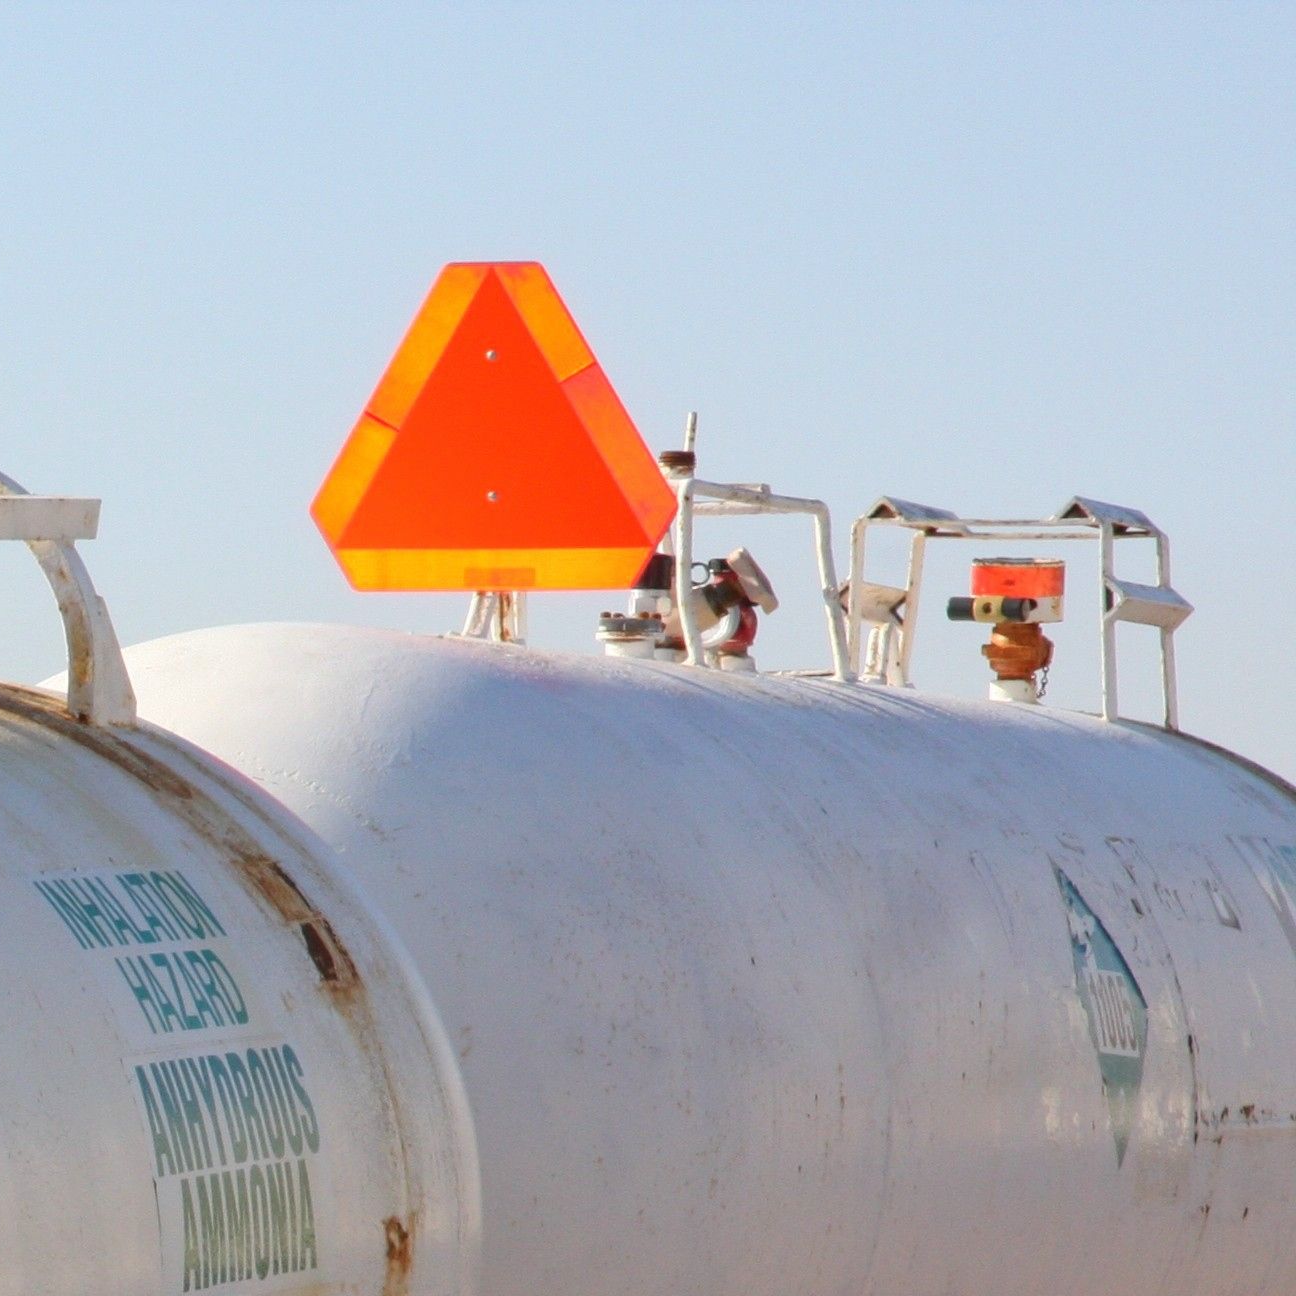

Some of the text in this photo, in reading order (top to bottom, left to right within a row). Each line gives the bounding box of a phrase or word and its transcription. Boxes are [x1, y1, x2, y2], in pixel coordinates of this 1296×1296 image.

[32, 870, 228, 950] INHALATION
[113, 949, 249, 1034] HAZARD
[134, 1042, 321, 1178] ANHYDROUS
[180, 1158, 318, 1293] AMMONIA
